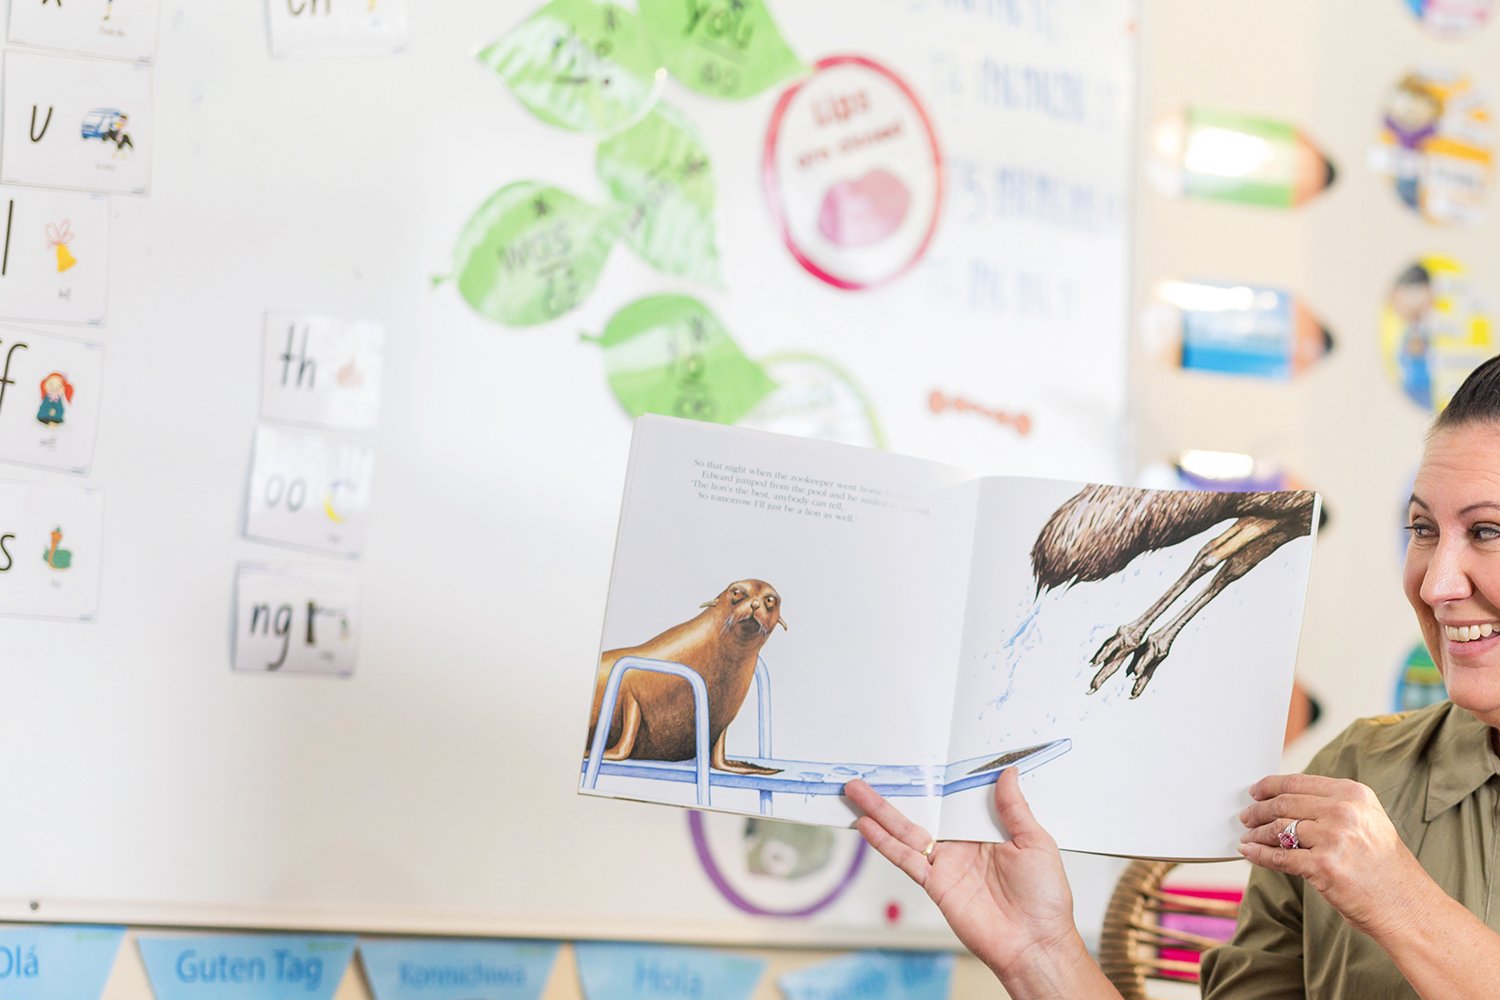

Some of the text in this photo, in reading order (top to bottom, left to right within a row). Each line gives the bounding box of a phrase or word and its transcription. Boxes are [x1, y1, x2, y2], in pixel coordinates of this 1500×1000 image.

[281, 322, 317, 389] th
[694, 459, 704, 467] So
[707, 461, 722, 470] that
[725, 464, 746, 475] night
[749, 467, 772, 478] when
[775, 470, 788, 480] the
[791, 475, 834, 488] zookeeper
[837, 482, 857, 491] went
[702, 470, 733, 482] Edward
[735, 477, 768, 489] jumped
[769, 481, 789, 490] from
[792, 483, 805, 492] the
[807, 488, 826, 498] pool
[829, 491, 845, 500] and
[847, 494, 858, 502] he
[698, 492, 708, 500] So
[710, 494, 751, 506] tomorrow
[754, 499, 765, 509] I'll
[767, 502, 781, 512] just
[784, 504, 794, 513] be
[805, 507, 821, 517] lion
[735, 486, 749, 495] the
[773, 493, 808, 505] anybody
[811, 500, 827, 508] can
[176, 949, 323, 991] Guten Tag
